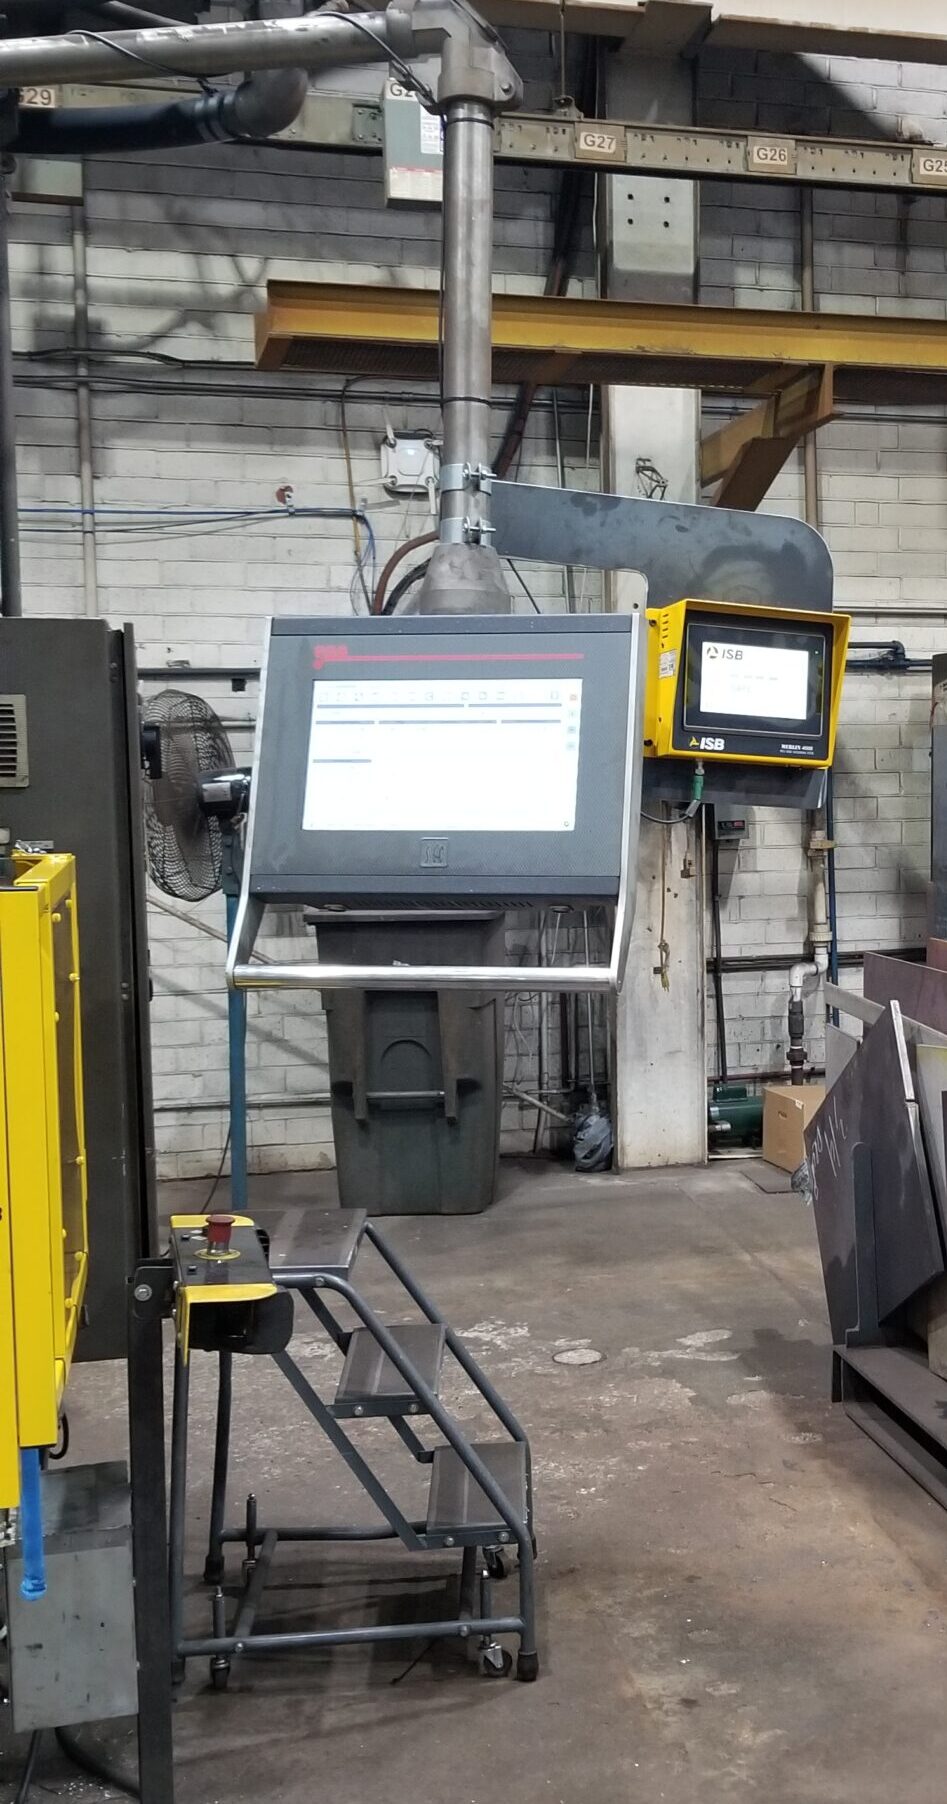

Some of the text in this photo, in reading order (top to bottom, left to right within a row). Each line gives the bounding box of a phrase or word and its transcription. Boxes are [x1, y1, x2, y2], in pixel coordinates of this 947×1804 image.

[390, 82, 414, 98] G2
[583, 133, 616, 150] G27
[756, 147, 787, 162] G26
[721, 648, 744, 661] ISB
[700, 737, 725, 751] ISB
